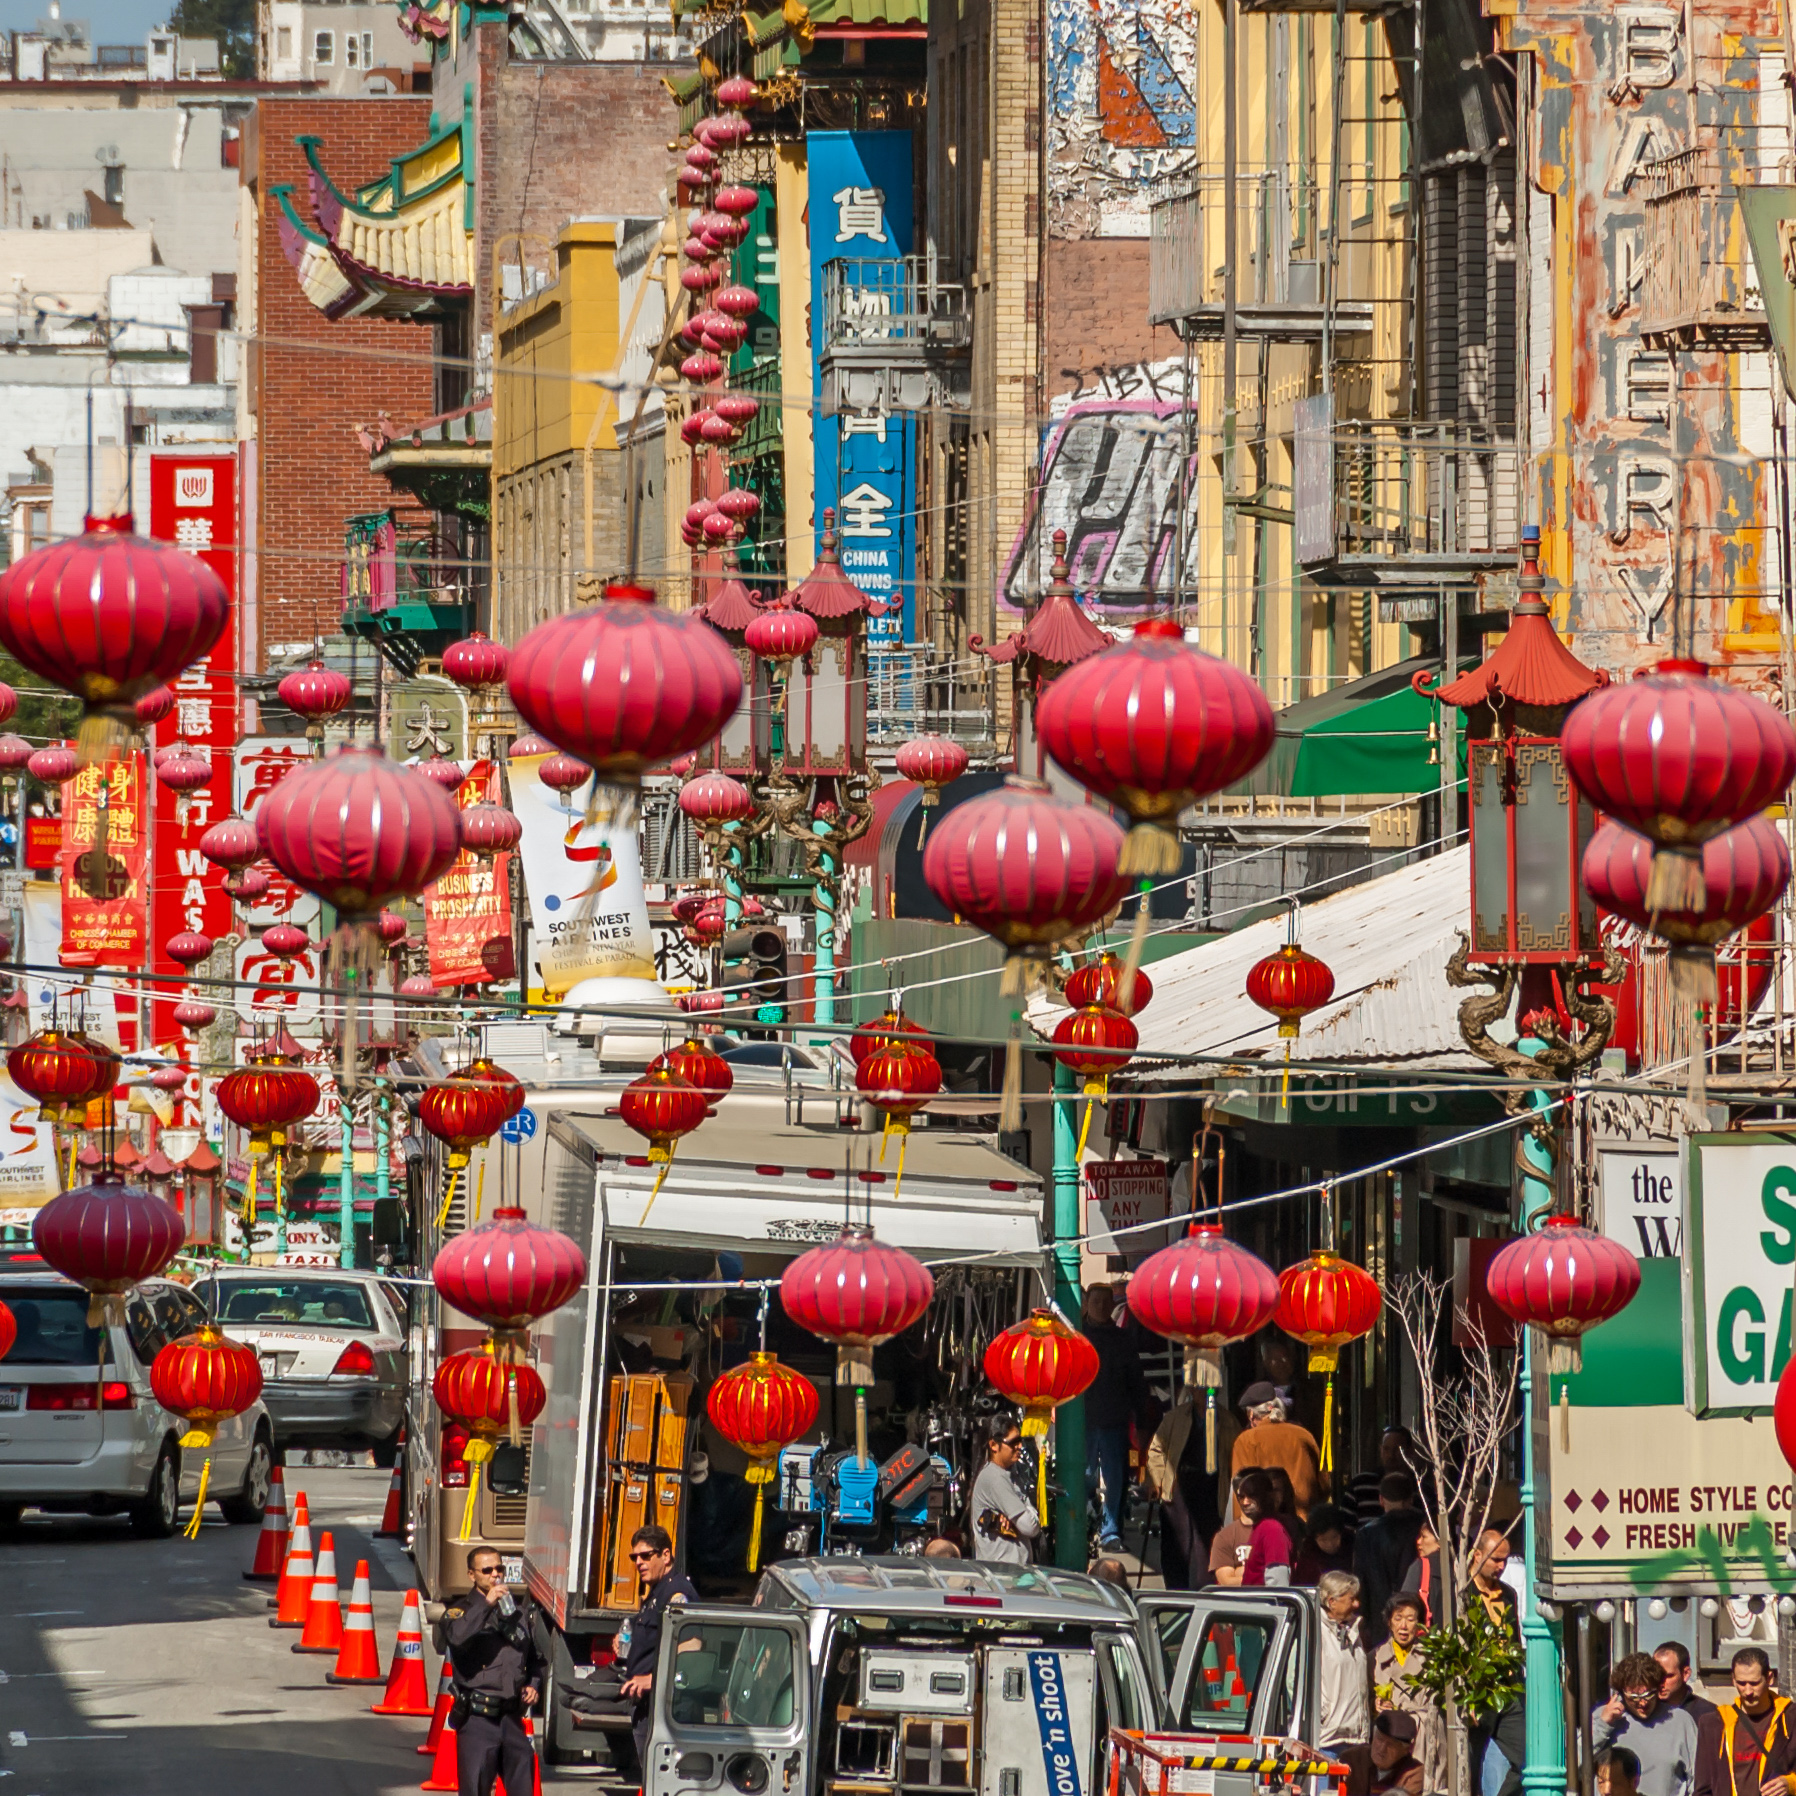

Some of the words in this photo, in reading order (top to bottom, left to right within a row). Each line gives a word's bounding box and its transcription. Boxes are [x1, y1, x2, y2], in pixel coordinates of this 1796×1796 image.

[843, 551, 889, 567] CHINA
[846, 574, 892, 589] OWNS
[406, 701, 454, 754] 大
[81, 853, 126, 873] GOD
[438, 872, 493, 895] BUSINESS
[615, 941, 636, 949] YEAR
[555, 958, 592, 970] FESTIVAL
[1093, 1165, 1157, 1176] TOW-AWAY
[1088, 1179, 1106, 1199] NO
[1112, 1180, 1163, 1195] STOPPING
[1632, 1165, 1673, 1203] the
[1112, 1201, 1141, 1216] ANY
[284, 1255, 328, 1265] TAXI
[1619, 1488, 1679, 1514] HOME
[1690, 1486, 1757, 1512] STYLE
[1626, 1523, 1695, 1549] FRESH
[1035, 1655, 1063, 1721] shoot
[1054, 1754, 1075, 1796] ove
